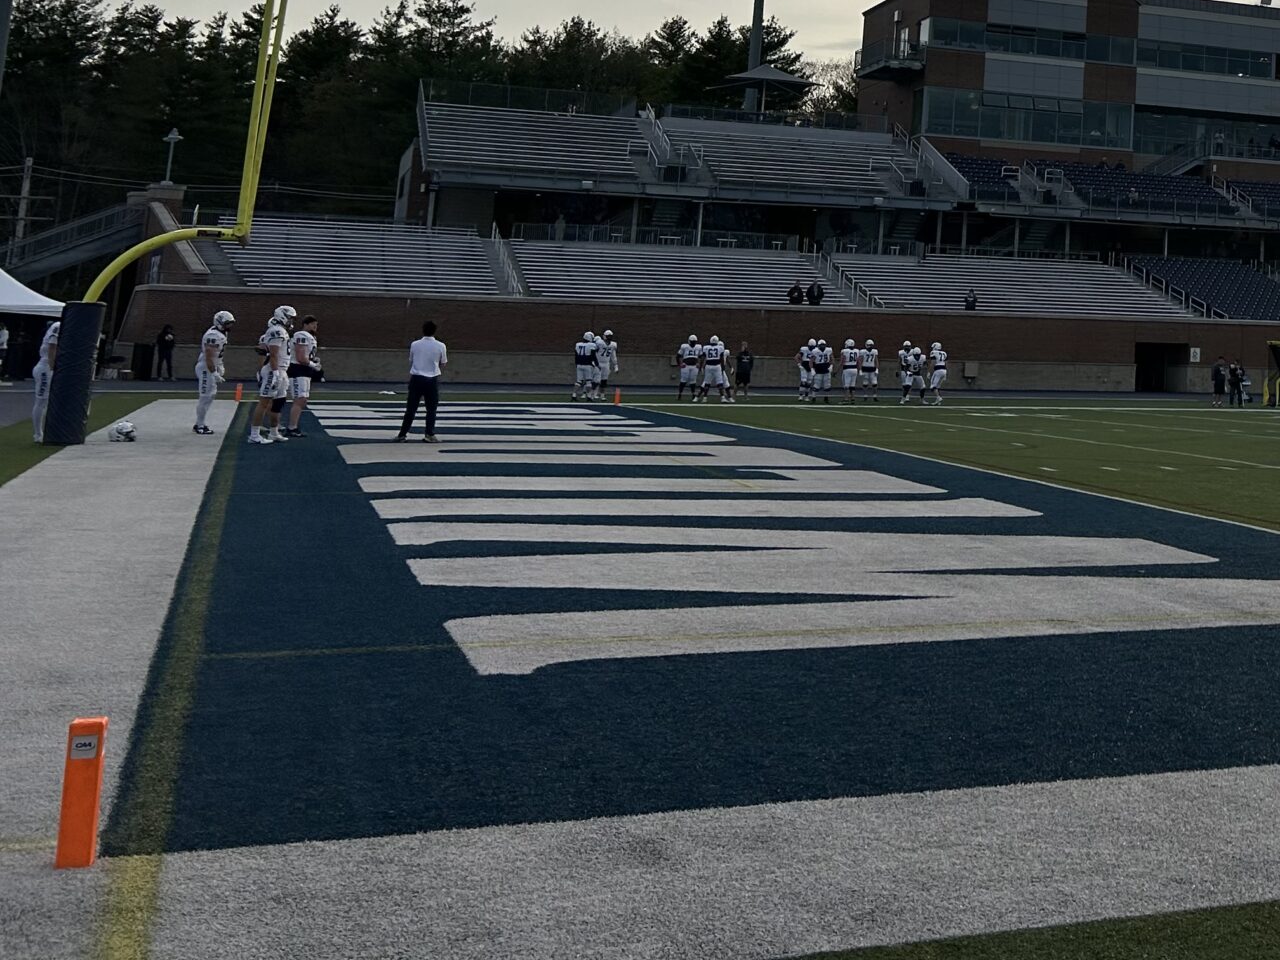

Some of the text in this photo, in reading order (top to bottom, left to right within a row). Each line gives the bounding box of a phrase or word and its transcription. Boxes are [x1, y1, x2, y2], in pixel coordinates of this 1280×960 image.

[579, 345, 586, 356] 71
[708, 348, 718, 358] 63
[866, 354, 874, 362] 77
